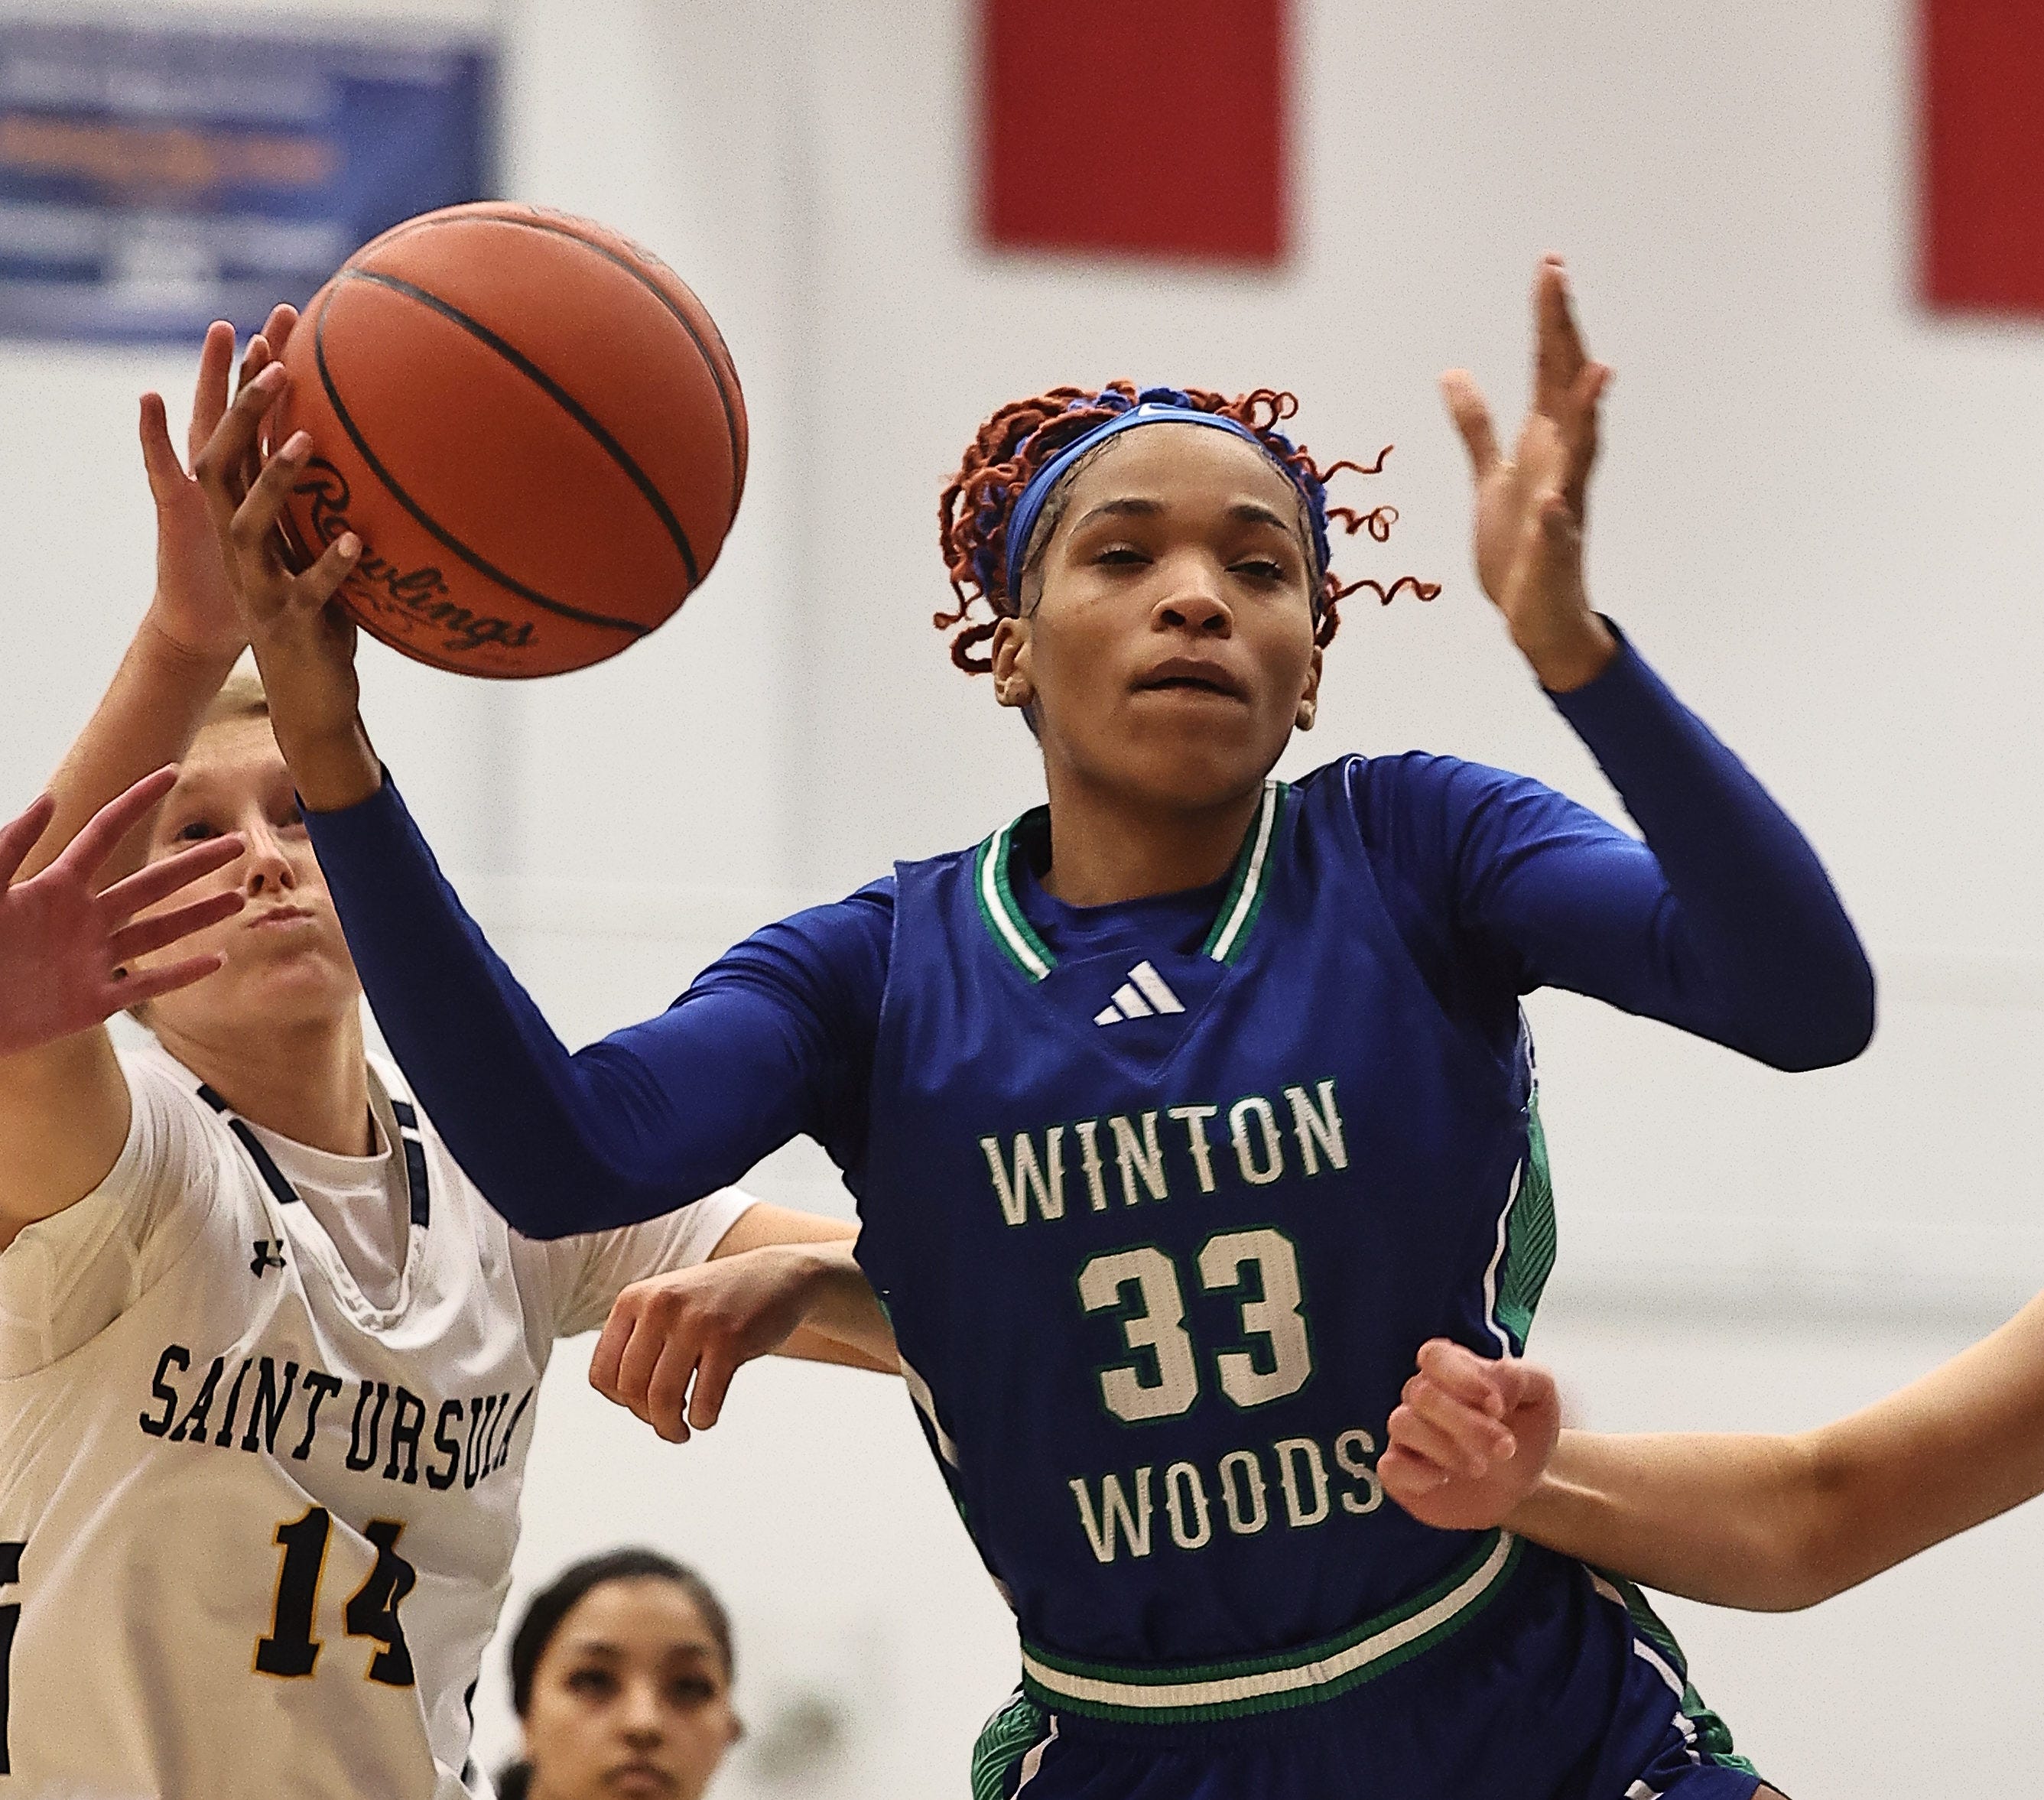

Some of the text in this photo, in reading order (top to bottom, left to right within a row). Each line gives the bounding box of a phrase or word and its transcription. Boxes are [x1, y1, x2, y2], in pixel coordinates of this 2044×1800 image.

[980, 1079, 1349, 1226] WINTON
[1077, 1228, 1313, 1422] 33
[139, 1344, 343, 1461] SAINT
[1069, 1430, 1383, 1564] WOODS
[252, 1503, 418, 1688] 14
